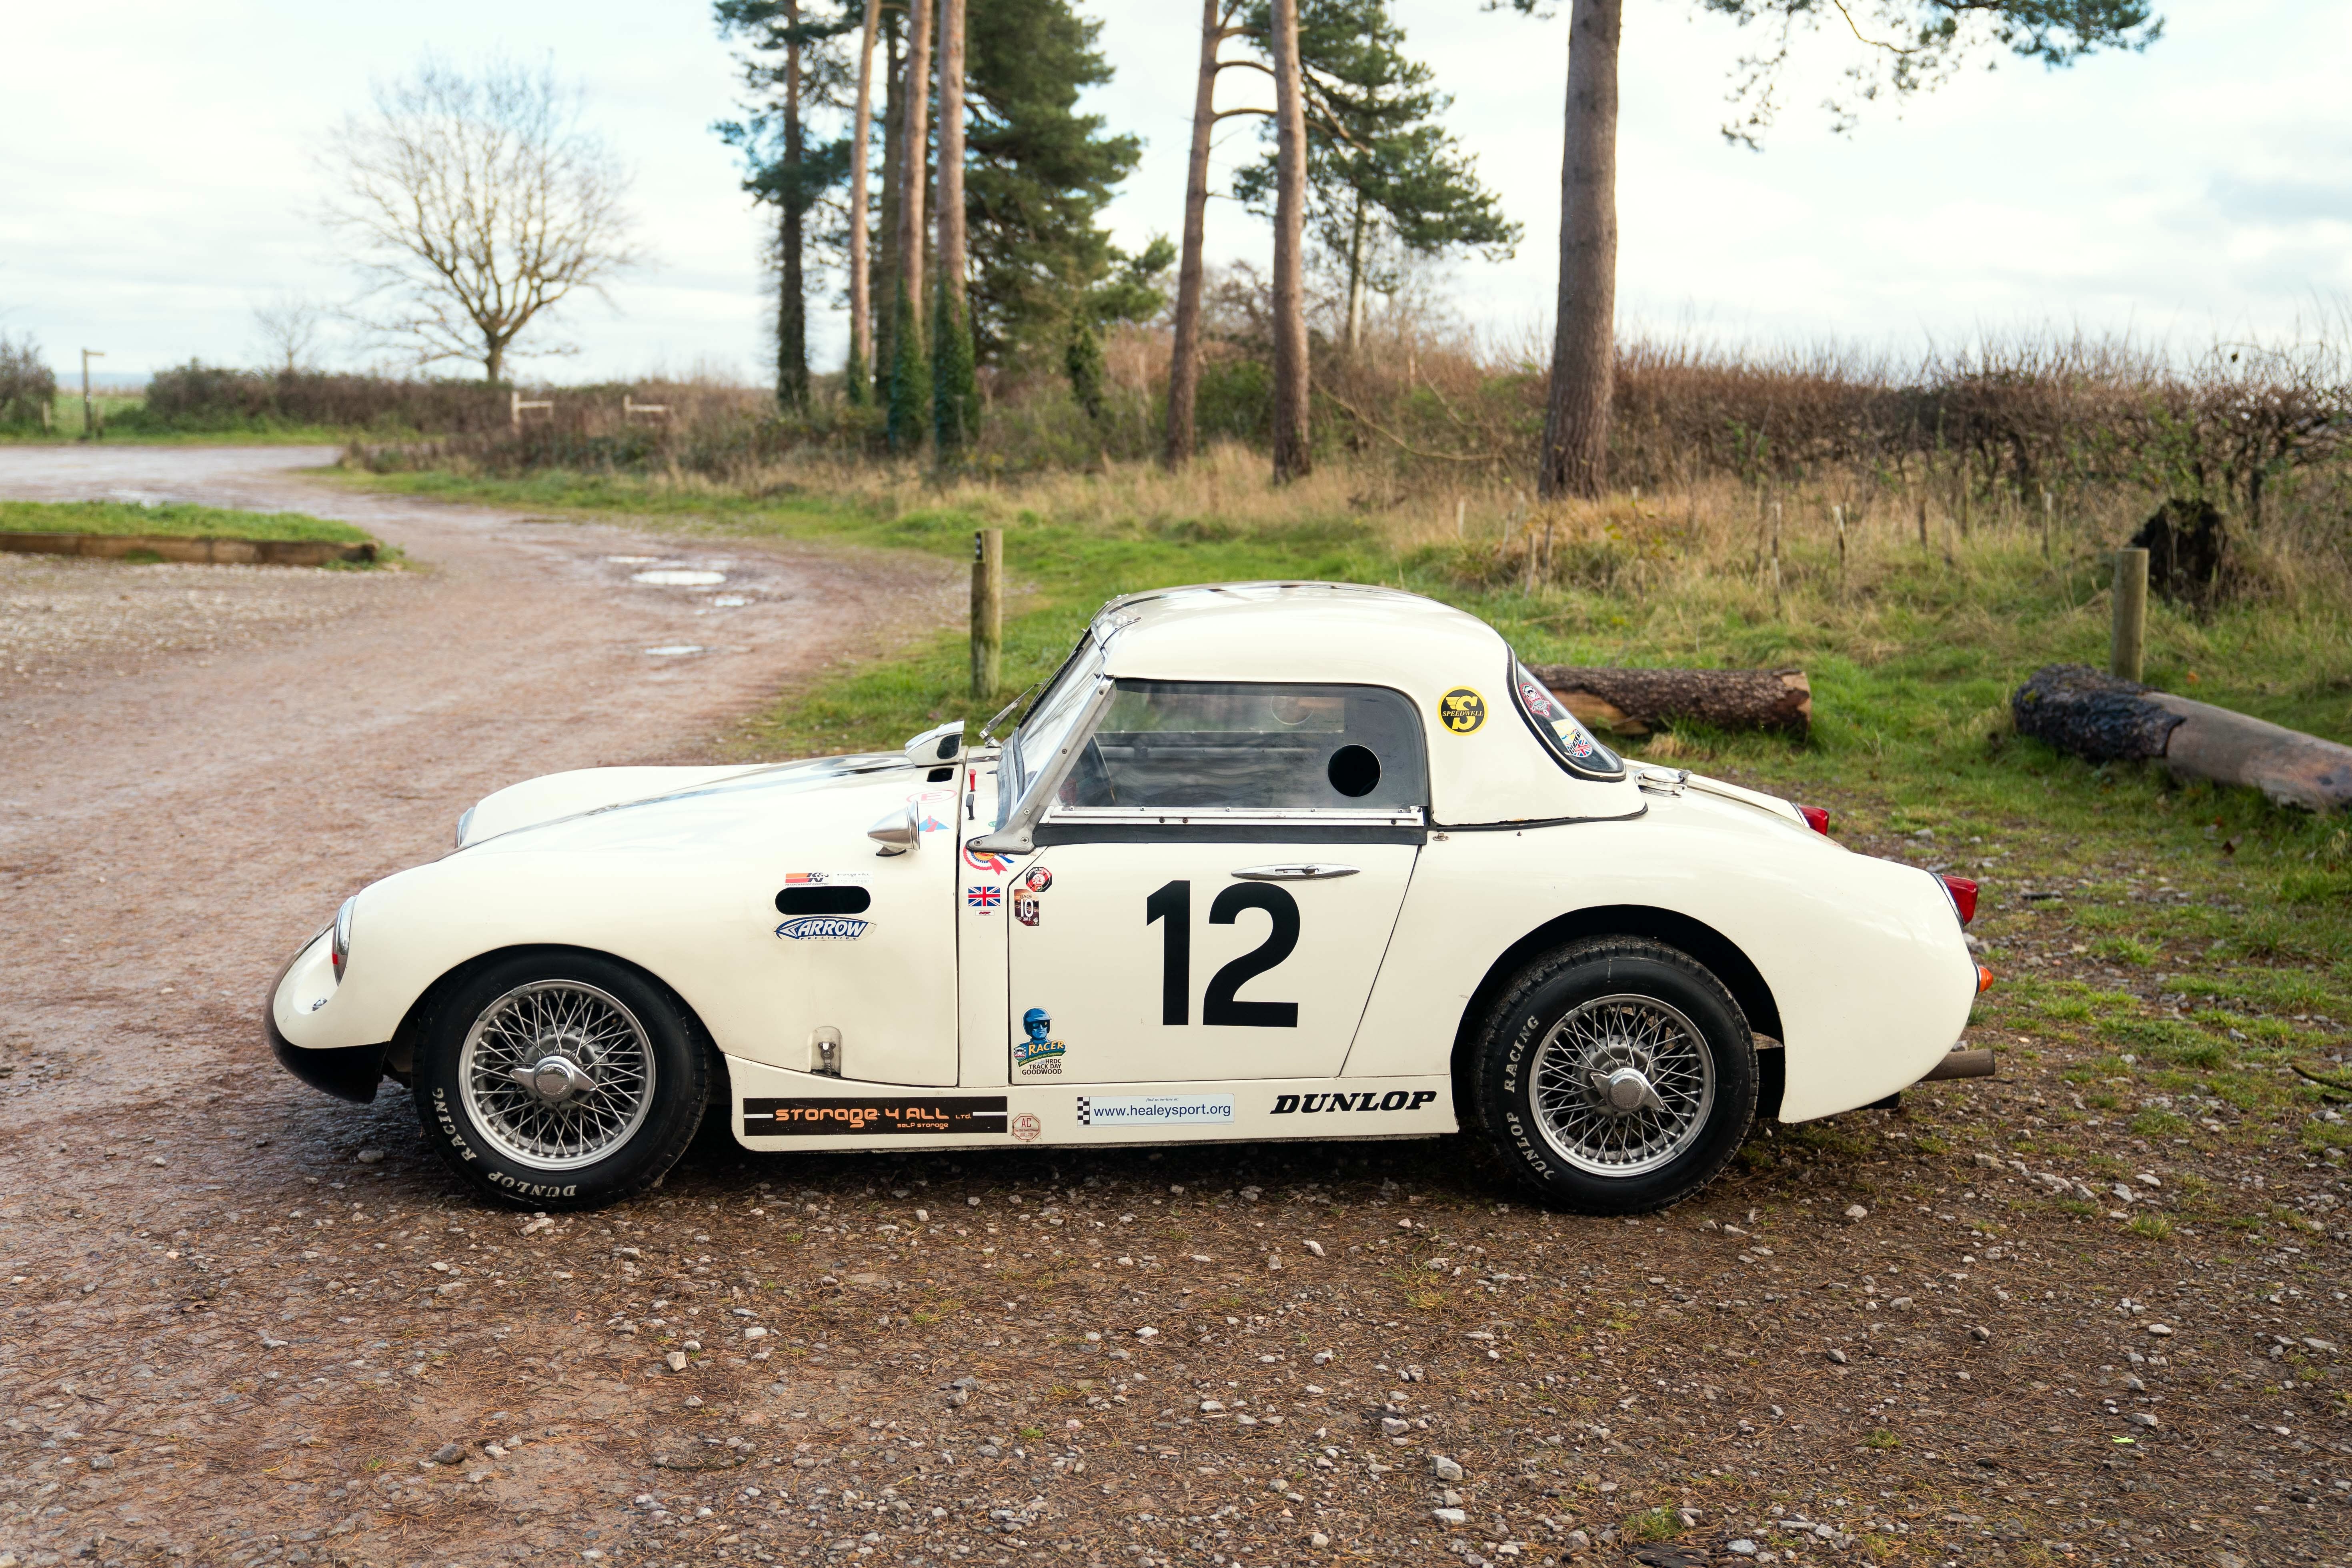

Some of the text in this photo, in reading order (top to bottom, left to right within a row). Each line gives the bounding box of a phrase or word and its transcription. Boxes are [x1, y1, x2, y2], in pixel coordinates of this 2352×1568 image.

[1569, 731, 1580, 753] HEALEY
[1021, 899, 1034, 917] 10
[797, 920, 867, 937] ARROW
[1147, 880, 1300, 1028] 12
[1029, 1041, 1064, 1056] RACER
[1505, 1015, 1539, 1093] RACING
[1094, 1104, 1231, 1118] www.healeysport.org
[1269, 1091, 1437, 1114] DUNLOP
[885, 1108, 899, 1119] 4
[906, 1108, 949, 1119] ALL
[1021, 1118, 1031, 1127] AC
[431, 1087, 477, 1161] RACING
[487, 1171, 577, 1197] DUNLOP
